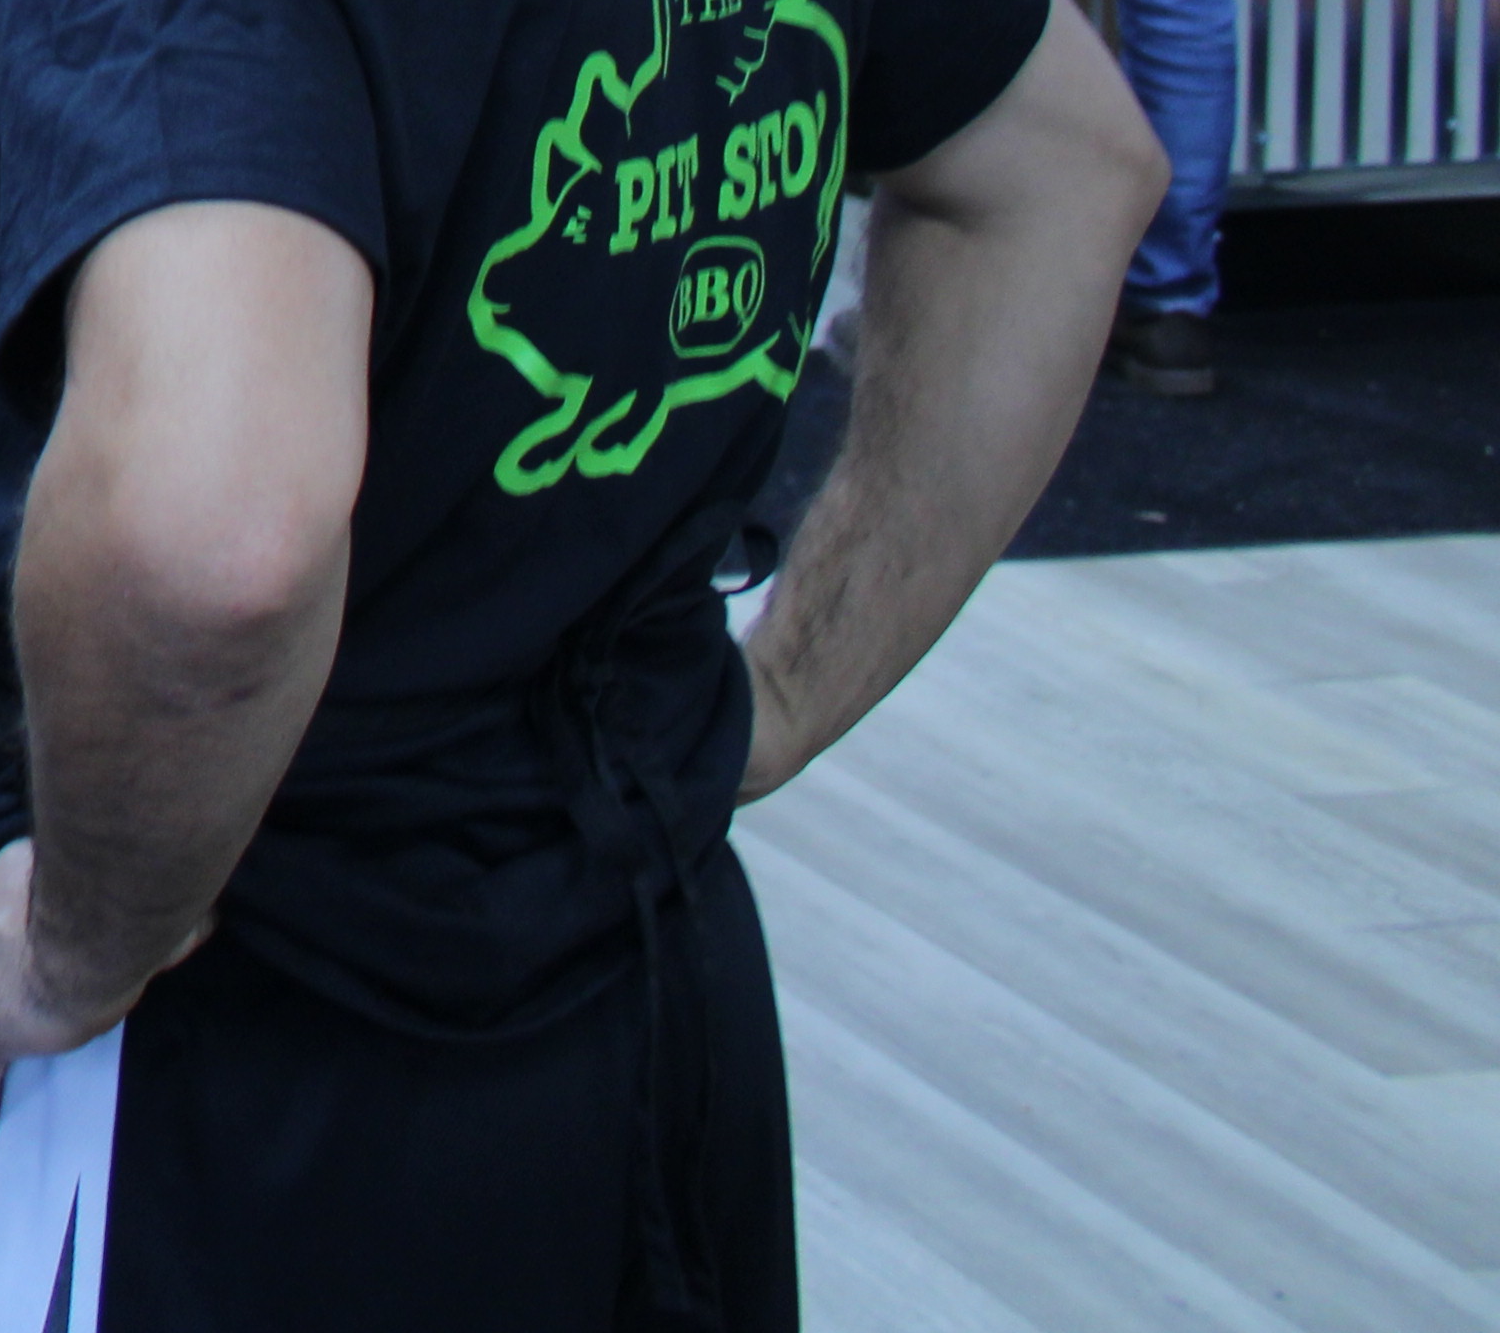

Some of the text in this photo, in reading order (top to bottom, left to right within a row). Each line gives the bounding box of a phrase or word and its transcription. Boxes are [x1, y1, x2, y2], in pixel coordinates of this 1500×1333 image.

[609, 89, 826, 255] PIT STO
[678, 259, 758, 333] BBQ
